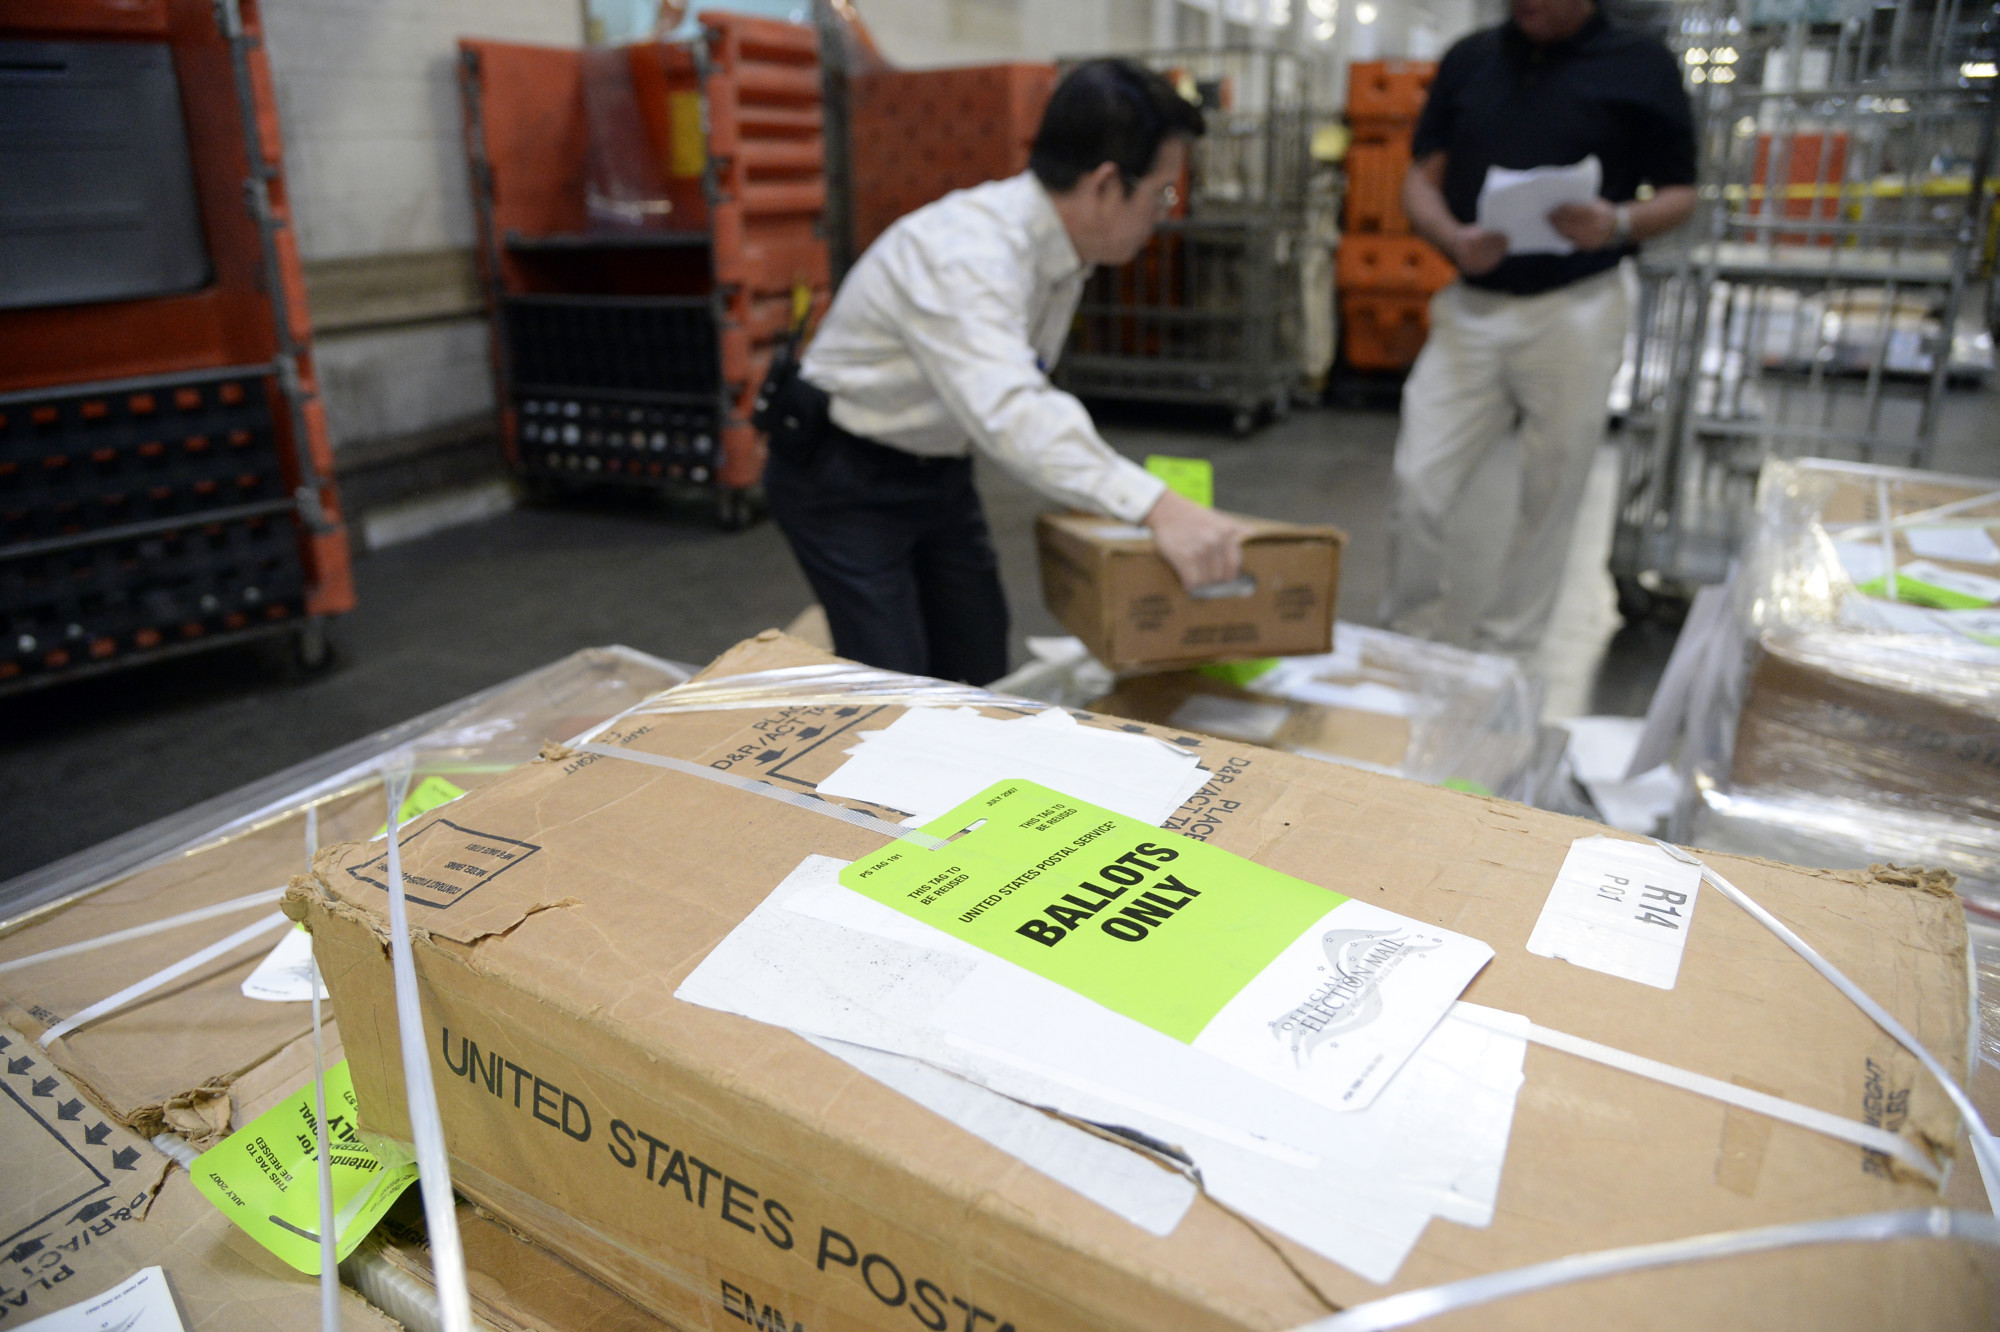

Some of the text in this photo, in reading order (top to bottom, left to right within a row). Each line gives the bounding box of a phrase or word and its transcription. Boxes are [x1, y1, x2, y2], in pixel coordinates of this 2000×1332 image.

[1018, 803, 1066, 829] THIS TAG TO
[1035, 808, 1078, 832] BE REUSED
[860, 853, 903, 879] PS TAG 191
[907, 866, 962, 900] THIS TAG TO
[920, 873, 970, 906] BE REUSED
[958, 893, 1003, 924] UNITED
[998, 868, 1041, 896] STATES
[1035, 846, 1079, 871] POSTAL
[1014, 841, 1180, 948] BALLOTS
[1100, 875, 1202, 943] ONLY
[1633, 882, 1689, 932] R14
[1281, 973, 1341, 1033] OFFICIAL
[1301, 962, 1375, 1034] ELECTION
[1371, 938, 1405, 968] MAIL
[245, 1142, 289, 1193] THIS TAG TO
[254, 1136, 294, 1182] BE REUSED
[296, 1133, 316, 1155] for
[208, 1171, 246, 1208] JULY 2007
[441, 1027, 1017, 1332] UNITED STATES POST
